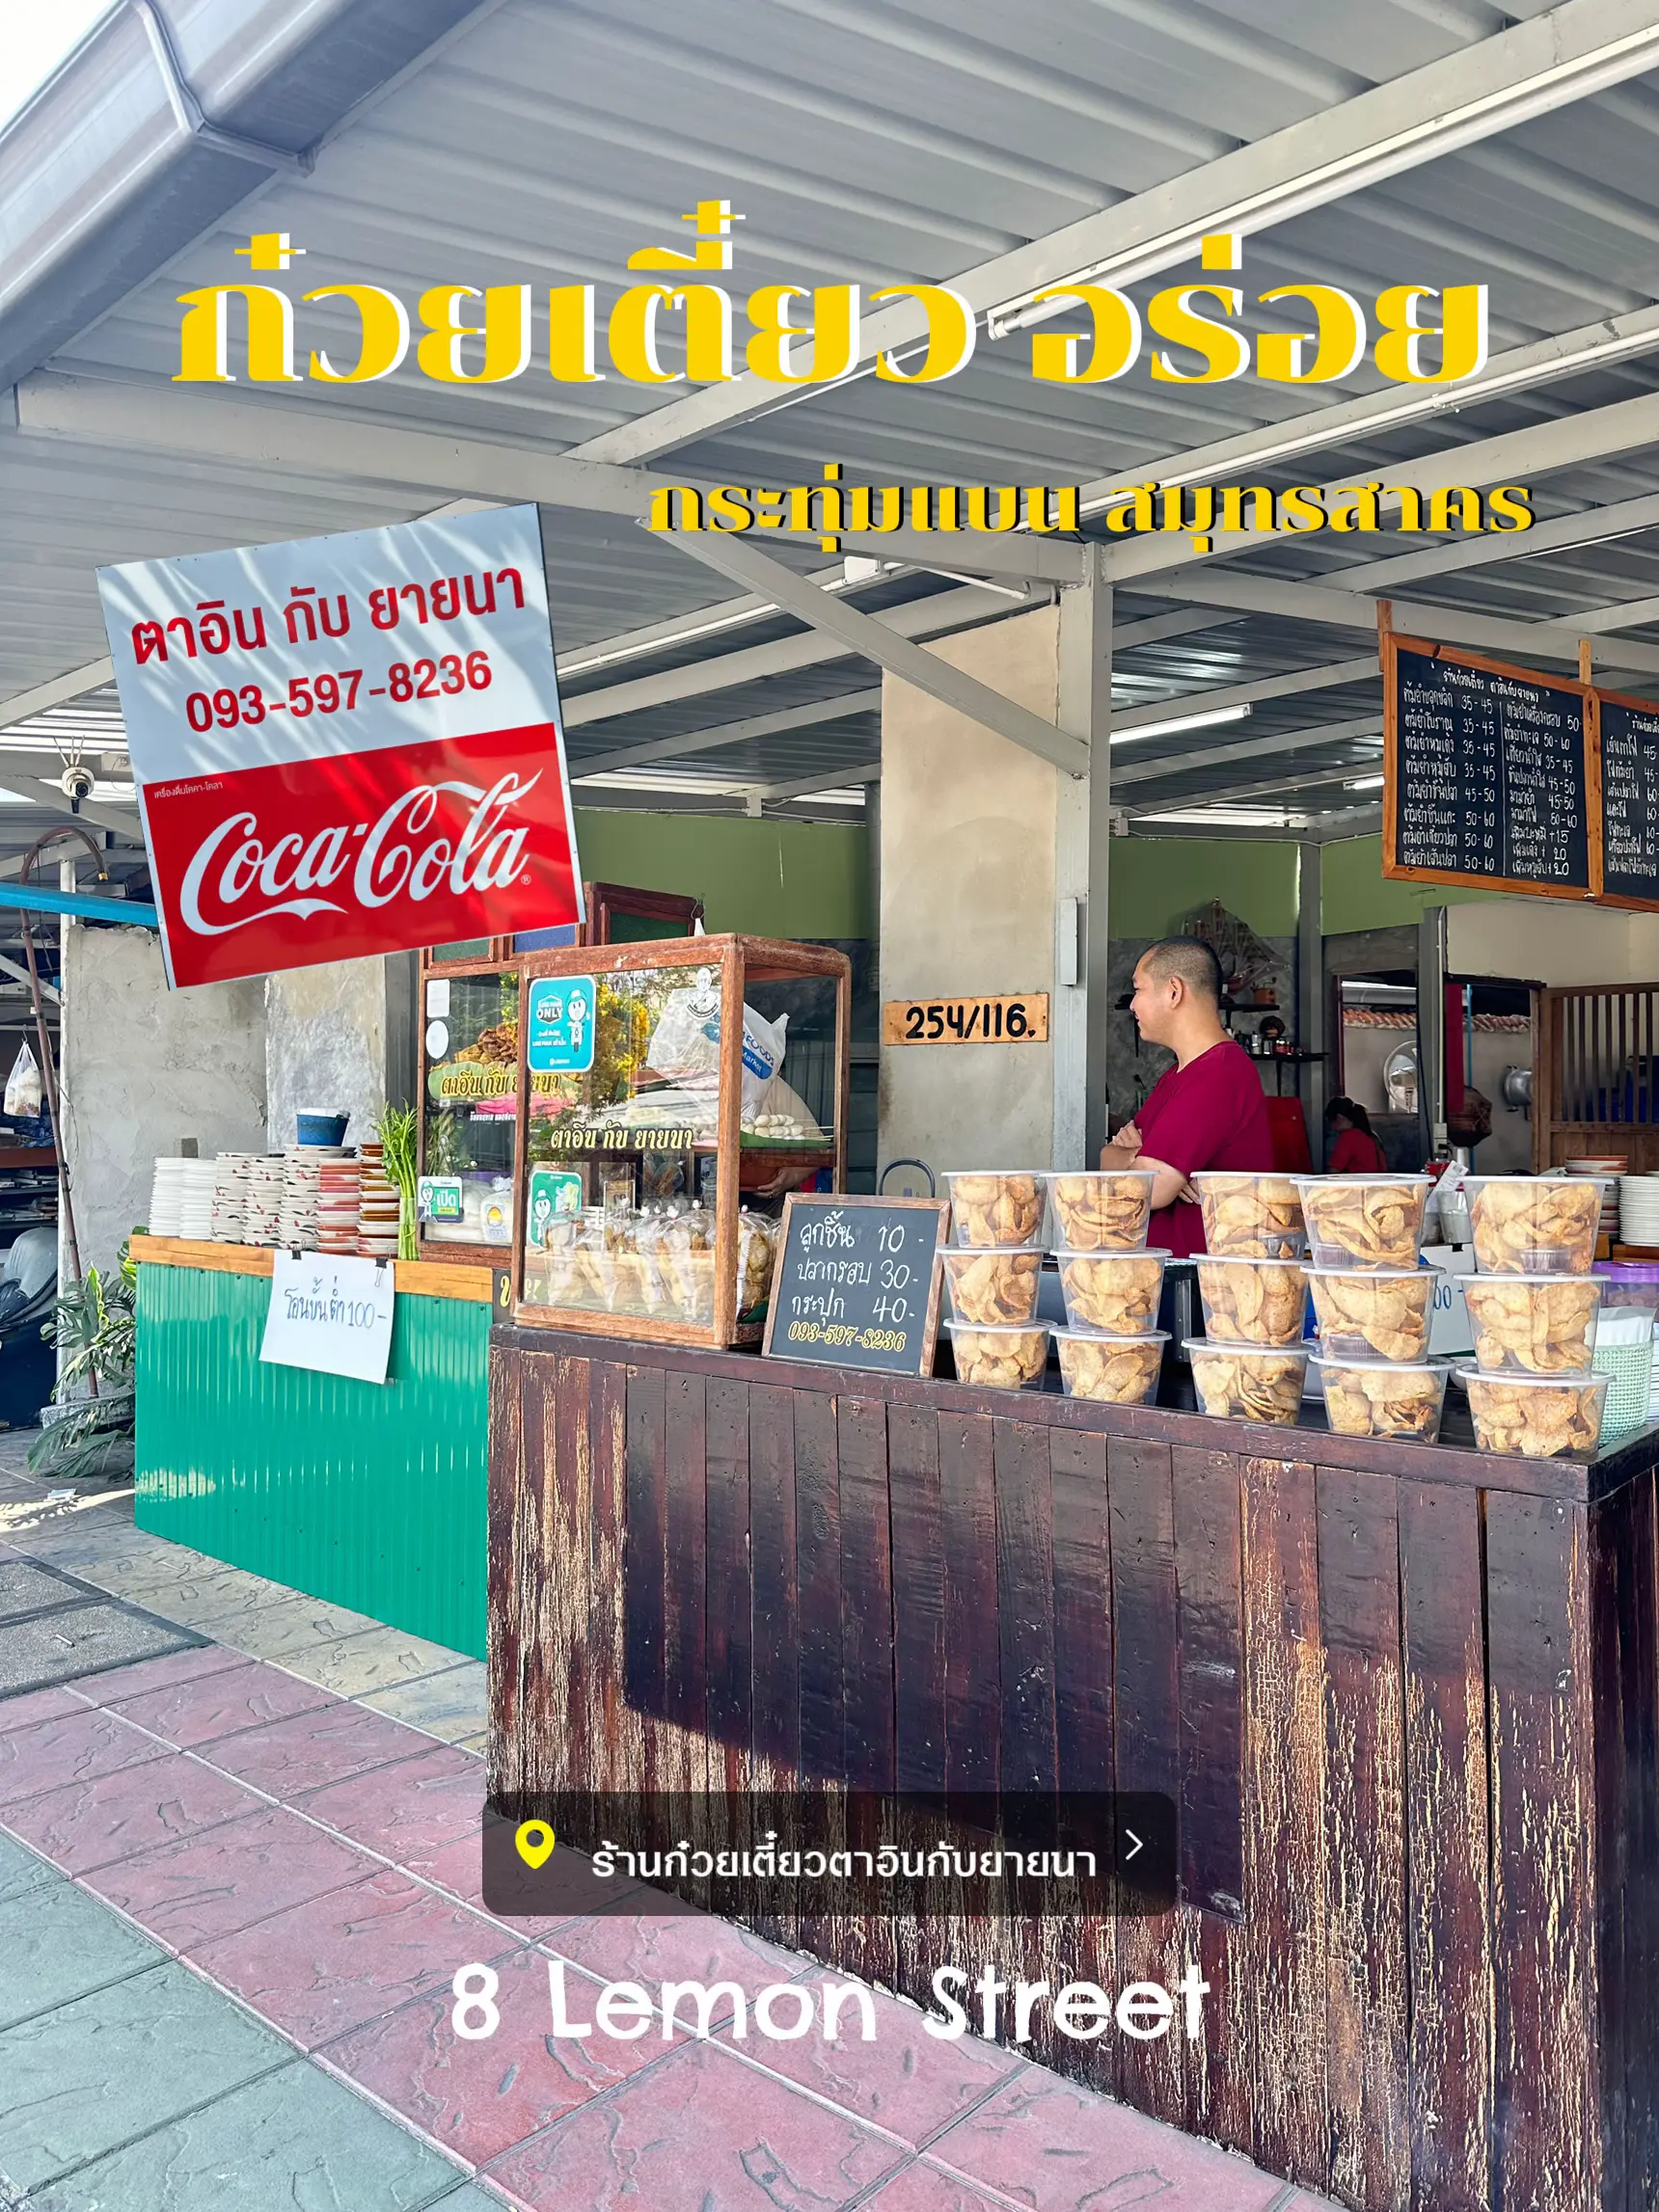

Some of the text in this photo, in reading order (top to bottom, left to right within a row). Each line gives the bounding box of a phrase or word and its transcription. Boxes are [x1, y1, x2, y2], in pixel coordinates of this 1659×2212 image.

[131, 567, 526, 665] ตาอิน กับ ยายนา
[185, 650, 494, 733] 093-597-8236
[179, 768, 544, 936] Coca-Cola
[536, 1007, 563, 1019] ONLY
[634, 1127, 694, 1150] ยายนา
[800, 1210, 856, 1253] ลูกชิ้น
[797, 1257, 872, 1286] ปลากรอบ
[791, 1287, 845, 1327] กระปุก
[787, 1320, 908, 1353] 093-597-8236
